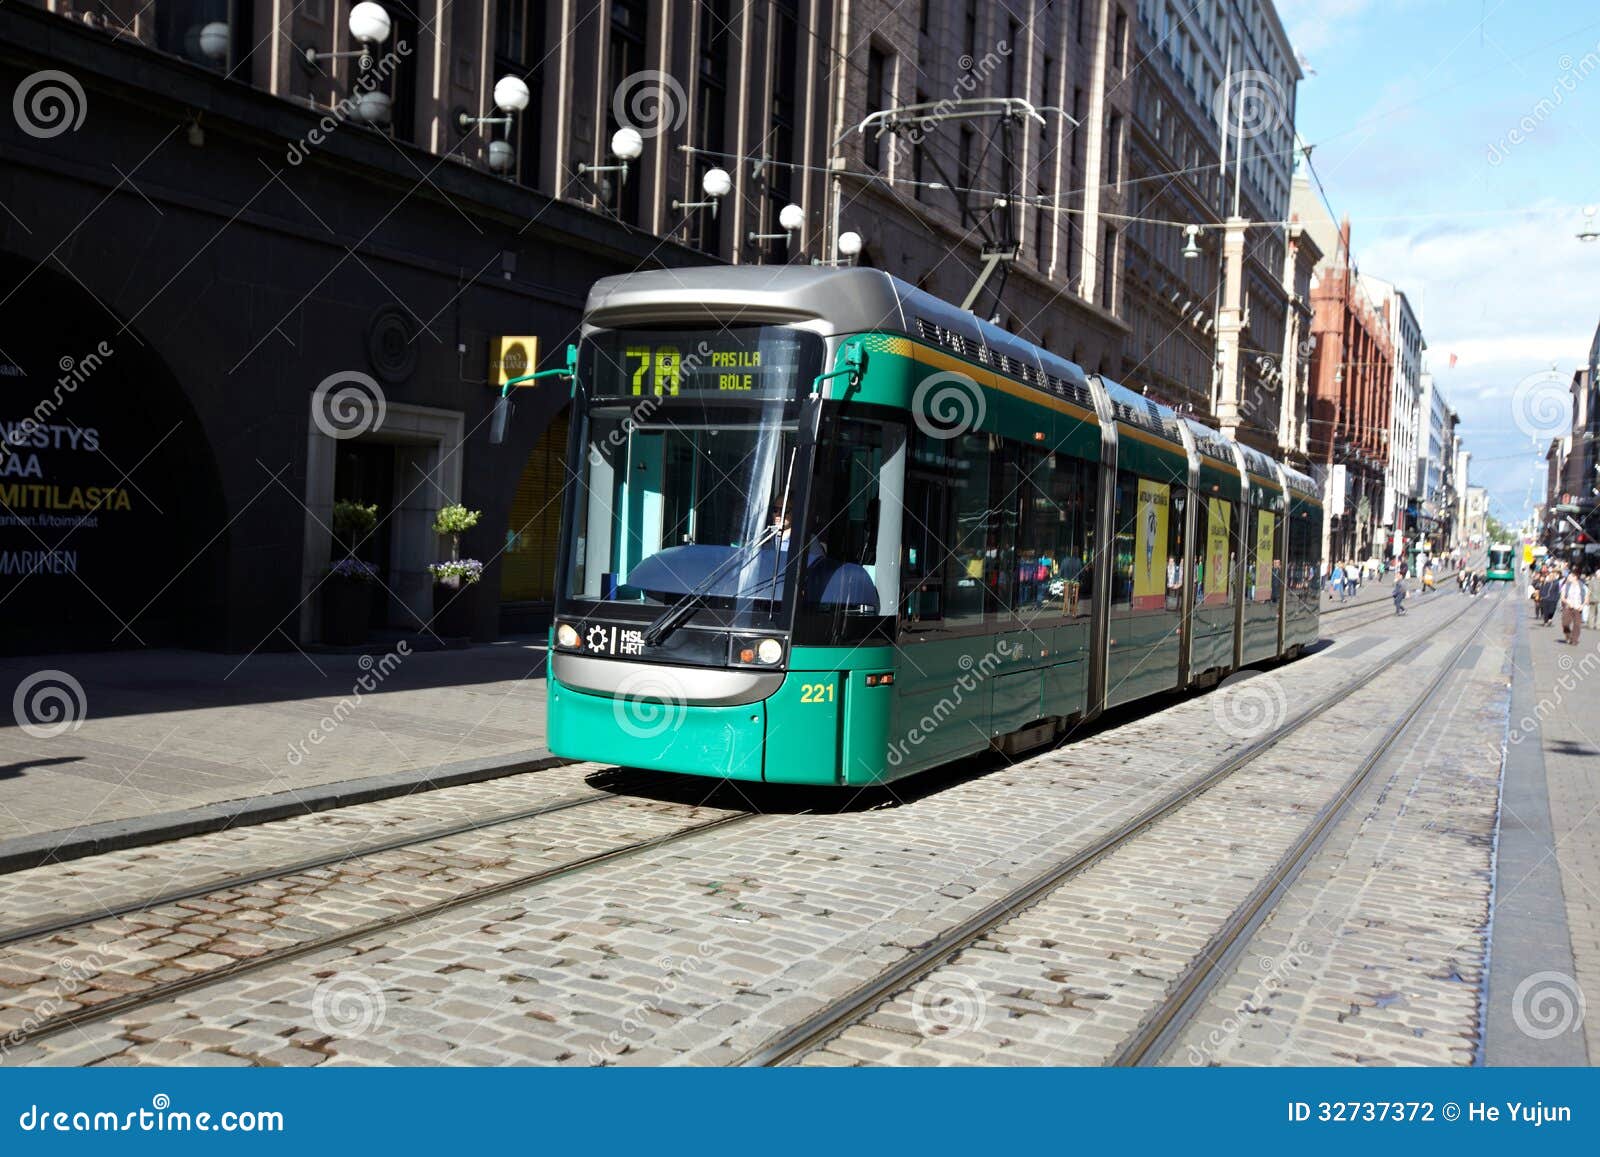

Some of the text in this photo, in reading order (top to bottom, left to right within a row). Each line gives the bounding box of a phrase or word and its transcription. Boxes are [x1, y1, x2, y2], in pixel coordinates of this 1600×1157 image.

[712, 351, 761, 367] PASILA
[625, 347, 681, 396] 7A
[719, 373, 752, 391] BÖLE
[620, 629, 645, 644] HSL
[620, 641, 645, 655] HRT
[800, 683, 835, 704] 221
